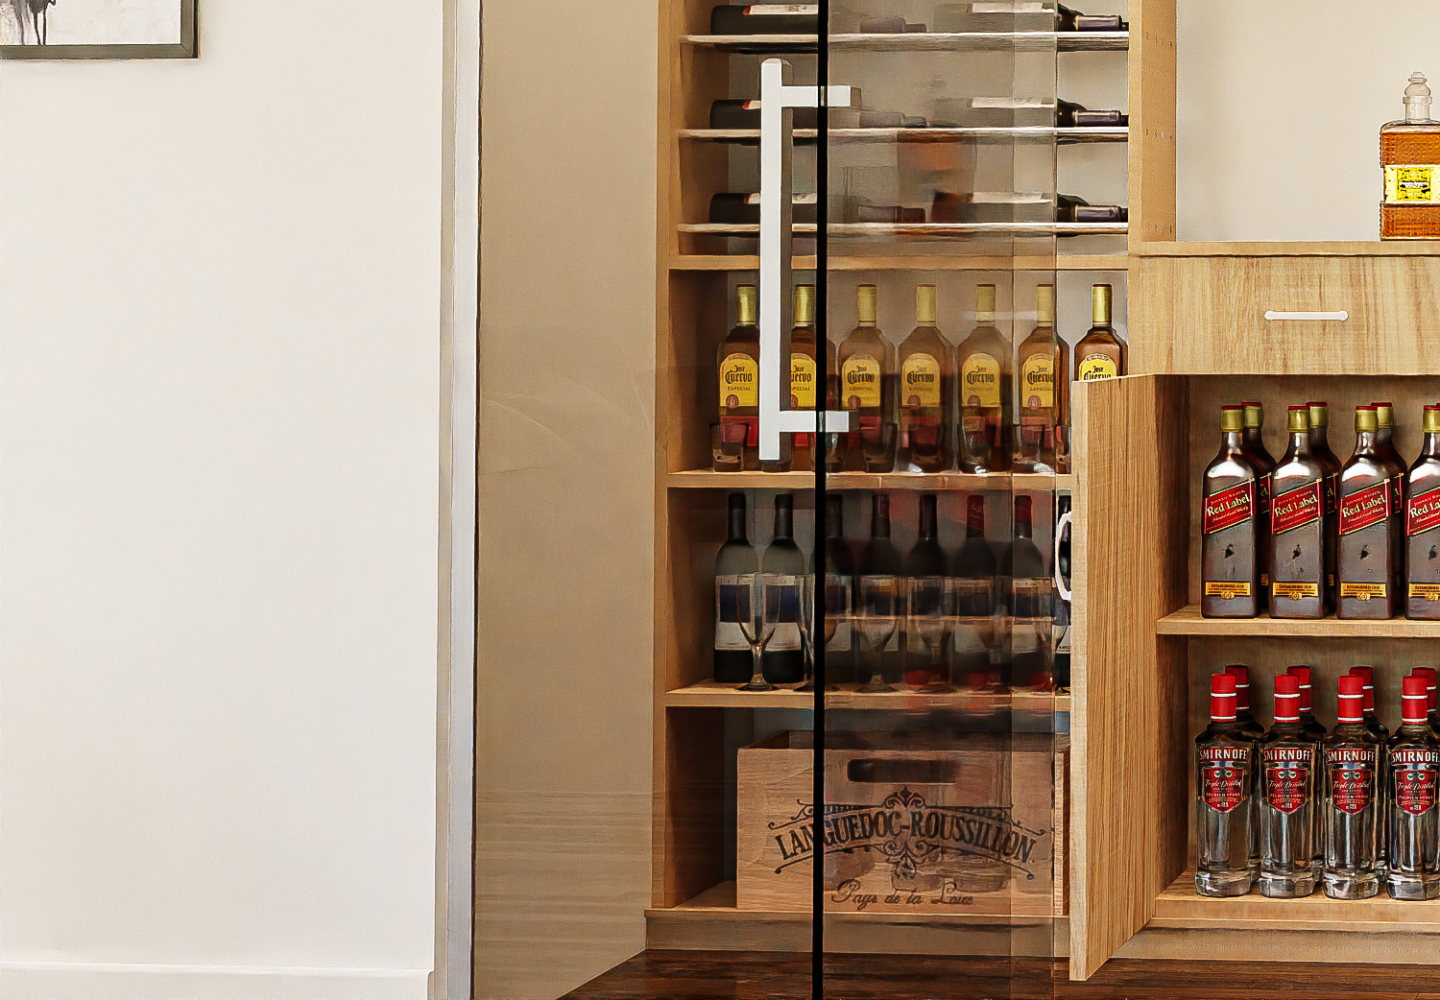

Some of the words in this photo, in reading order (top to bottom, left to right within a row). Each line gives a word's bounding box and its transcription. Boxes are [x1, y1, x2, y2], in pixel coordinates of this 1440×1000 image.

[725, 370, 752, 384] Cuervo
[791, 371, 811, 383] uervo
[1207, 501, 1225, 517] Red
[1226, 494, 1250, 510] Label
[1274, 501, 1293, 517] Red
[1293, 494, 1318, 510] Label
[1342, 502, 1360, 518] Red
[1362, 495, 1386, 510] Label
[1410, 502, 1428, 518] Red
[1200, 749, 1246, 760] SMIRNOFF
[1264, 750, 1310, 760] SMIRNOFF
[1327, 751, 1374, 761] SMIRNOFF
[1392, 752, 1438, 762] SMIRNOFF
[832, 879, 877, 910] Pays
[884, 889, 900, 904] de
